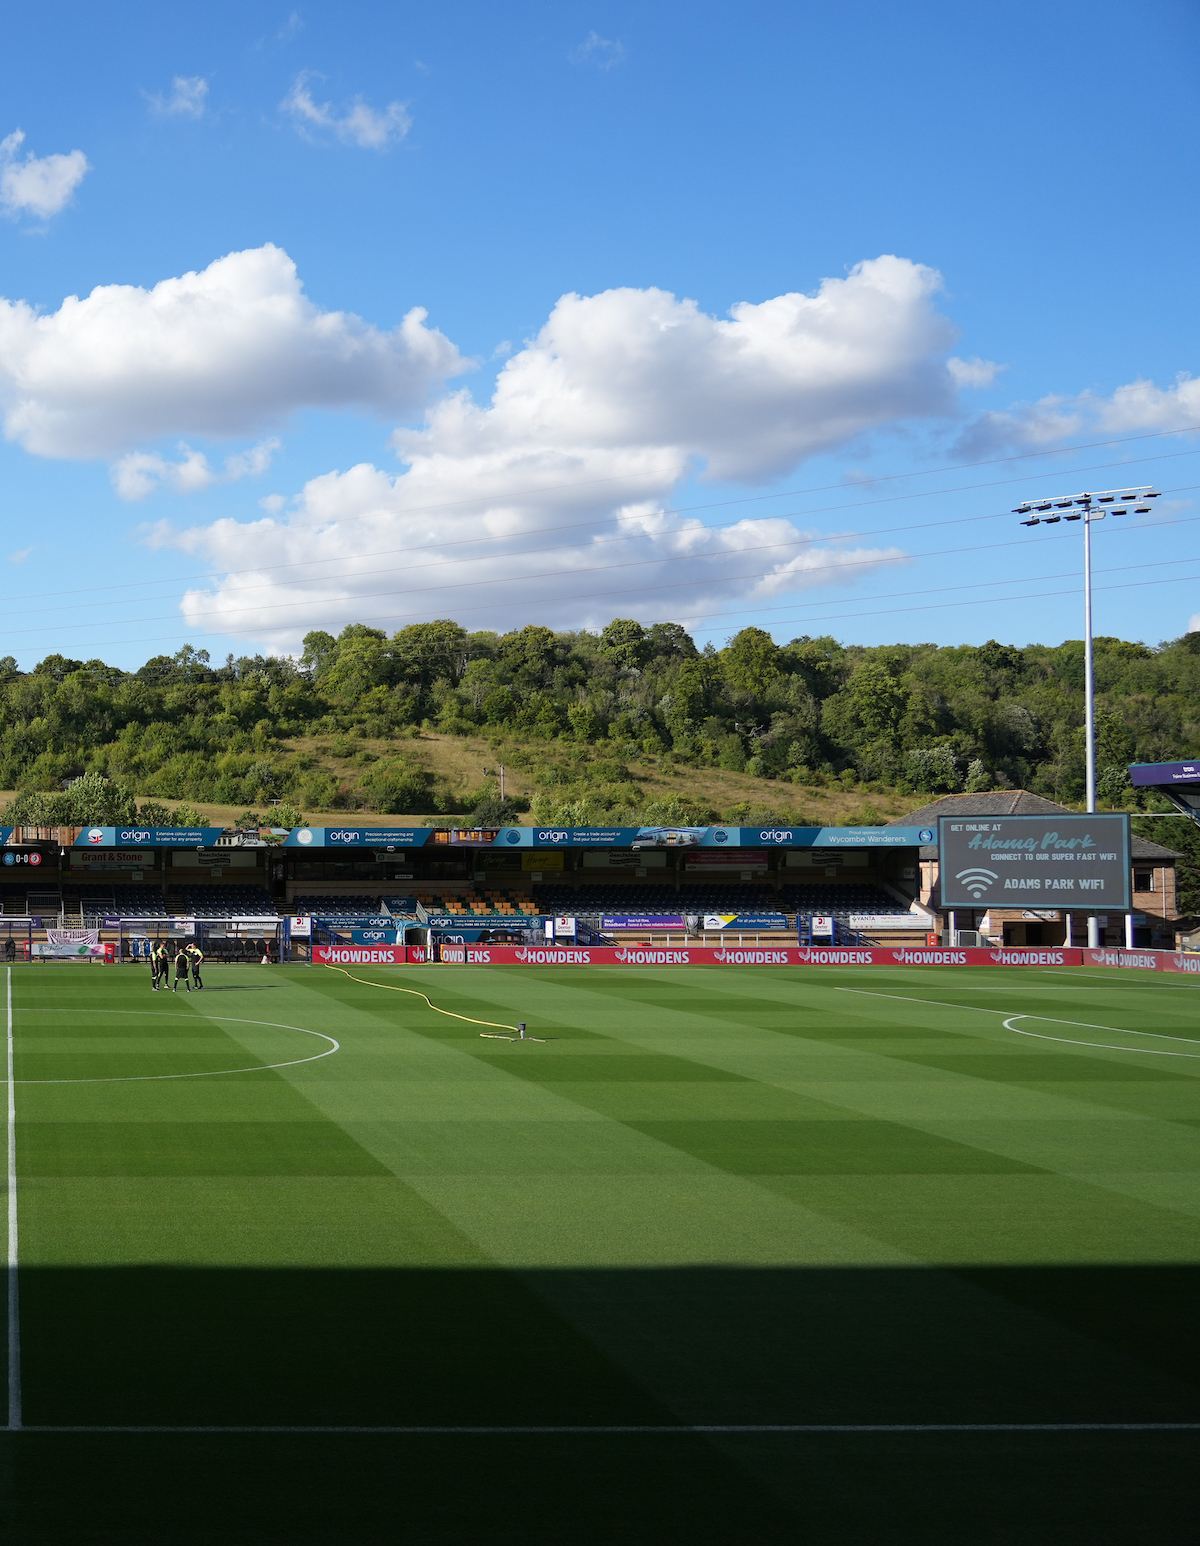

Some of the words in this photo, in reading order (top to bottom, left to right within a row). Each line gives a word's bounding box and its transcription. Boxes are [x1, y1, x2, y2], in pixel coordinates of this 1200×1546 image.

[951, 824, 963, 832] GET
[121, 829, 151, 842] origin
[330, 830, 360, 843] origin
[538, 830, 568, 842] origin
[760, 828, 792, 843] origin
[828, 835, 866, 844] Wycombe
[868, 835, 906, 843] Wanderers
[968, 833, 1039, 852] Adams
[1040, 831, 1096, 849] Park
[82, 852, 107, 862] Grant
[108, 852, 115, 862] &
[117, 852, 143, 862] Stone
[991, 853, 1022, 861] CONNECT
[1024, 853, 1034, 861] TO
[1036, 853, 1049, 861] OUR
[1051, 853, 1074, 861] SUPER
[1076, 853, 1096, 861] FAST
[1099, 853, 1117, 861] WIFI
[1004, 879, 1041, 890] ADAMS
[1044, 879, 1074, 890] PARK
[1079, 879, 1105, 890] WIFI
[369, 917, 392, 927] origin
[430, 918, 452, 927] origin
[363, 930, 386, 940] origin
[331, 950, 395, 963] HOWDENS
[527, 951, 591, 964] HOWDENS
[627, 951, 690, 964] HOWDENS
[726, 951, 788, 964] HOWDENS
[810, 951, 873, 964] HOWDENS
[904, 951, 967, 964] HOWDENS
[1002, 952, 1064, 965] HOWDENS
[1105, 953, 1156, 969] HOWDENS
